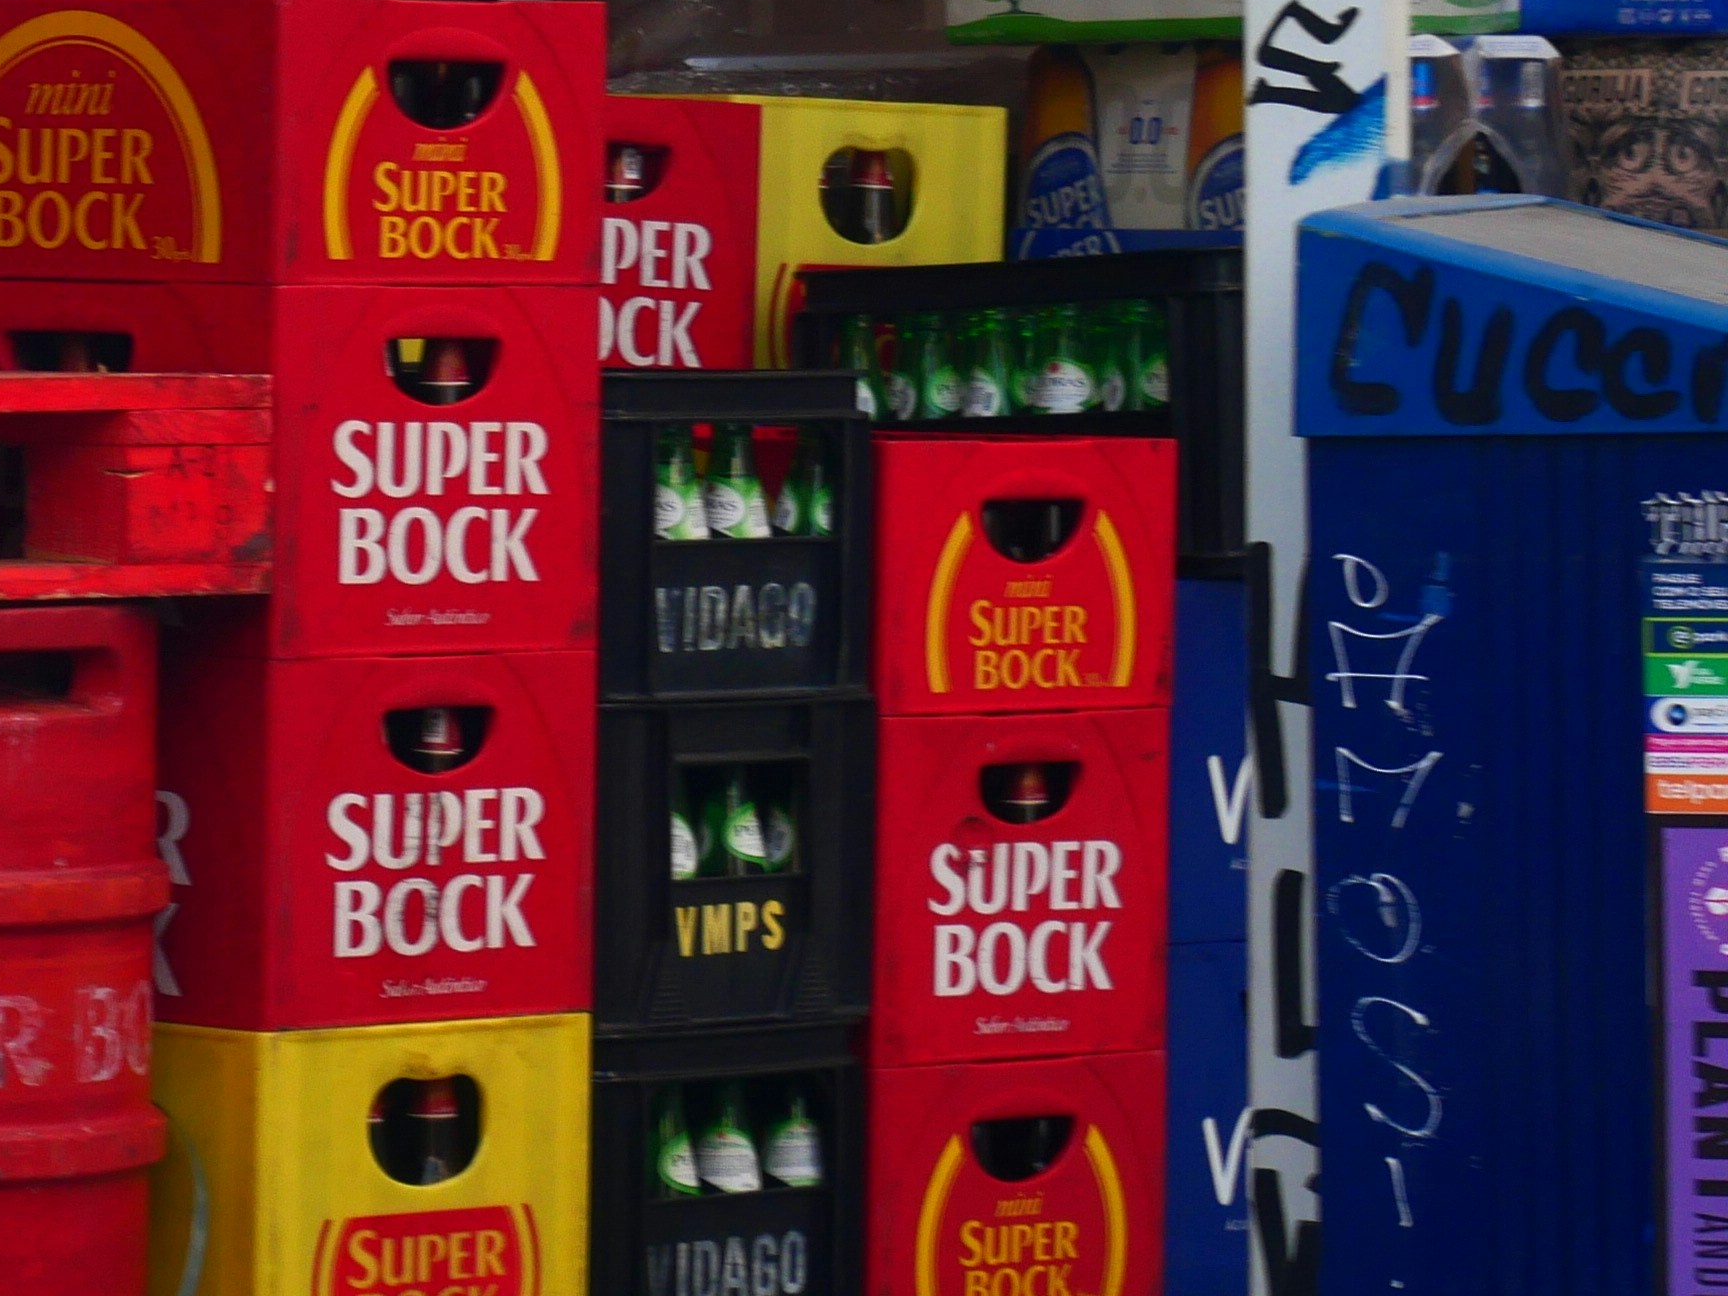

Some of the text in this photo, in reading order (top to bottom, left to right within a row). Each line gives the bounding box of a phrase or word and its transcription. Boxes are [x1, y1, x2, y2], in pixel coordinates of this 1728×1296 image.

[24, 68, 117, 116] mini
[372, 160, 508, 213] SUPER
[378, 215, 502, 260] BOCK
[331, 419, 552, 499] SUPER
[339, 506, 542, 586] BOCK
[968, 598, 1088, 647] SUPER
[974, 648, 1082, 690] BOCK
[324, 787, 547, 873] SUPER
[927, 839, 1124, 917] SUPER
[333, 872, 538, 958] BOCK
[674, 899, 786, 957] VMPS
[933, 919, 1115, 998] BOCK
[346, 1228, 508, 1290] SUPER
[959, 1220, 1080, 1268] SUPER
